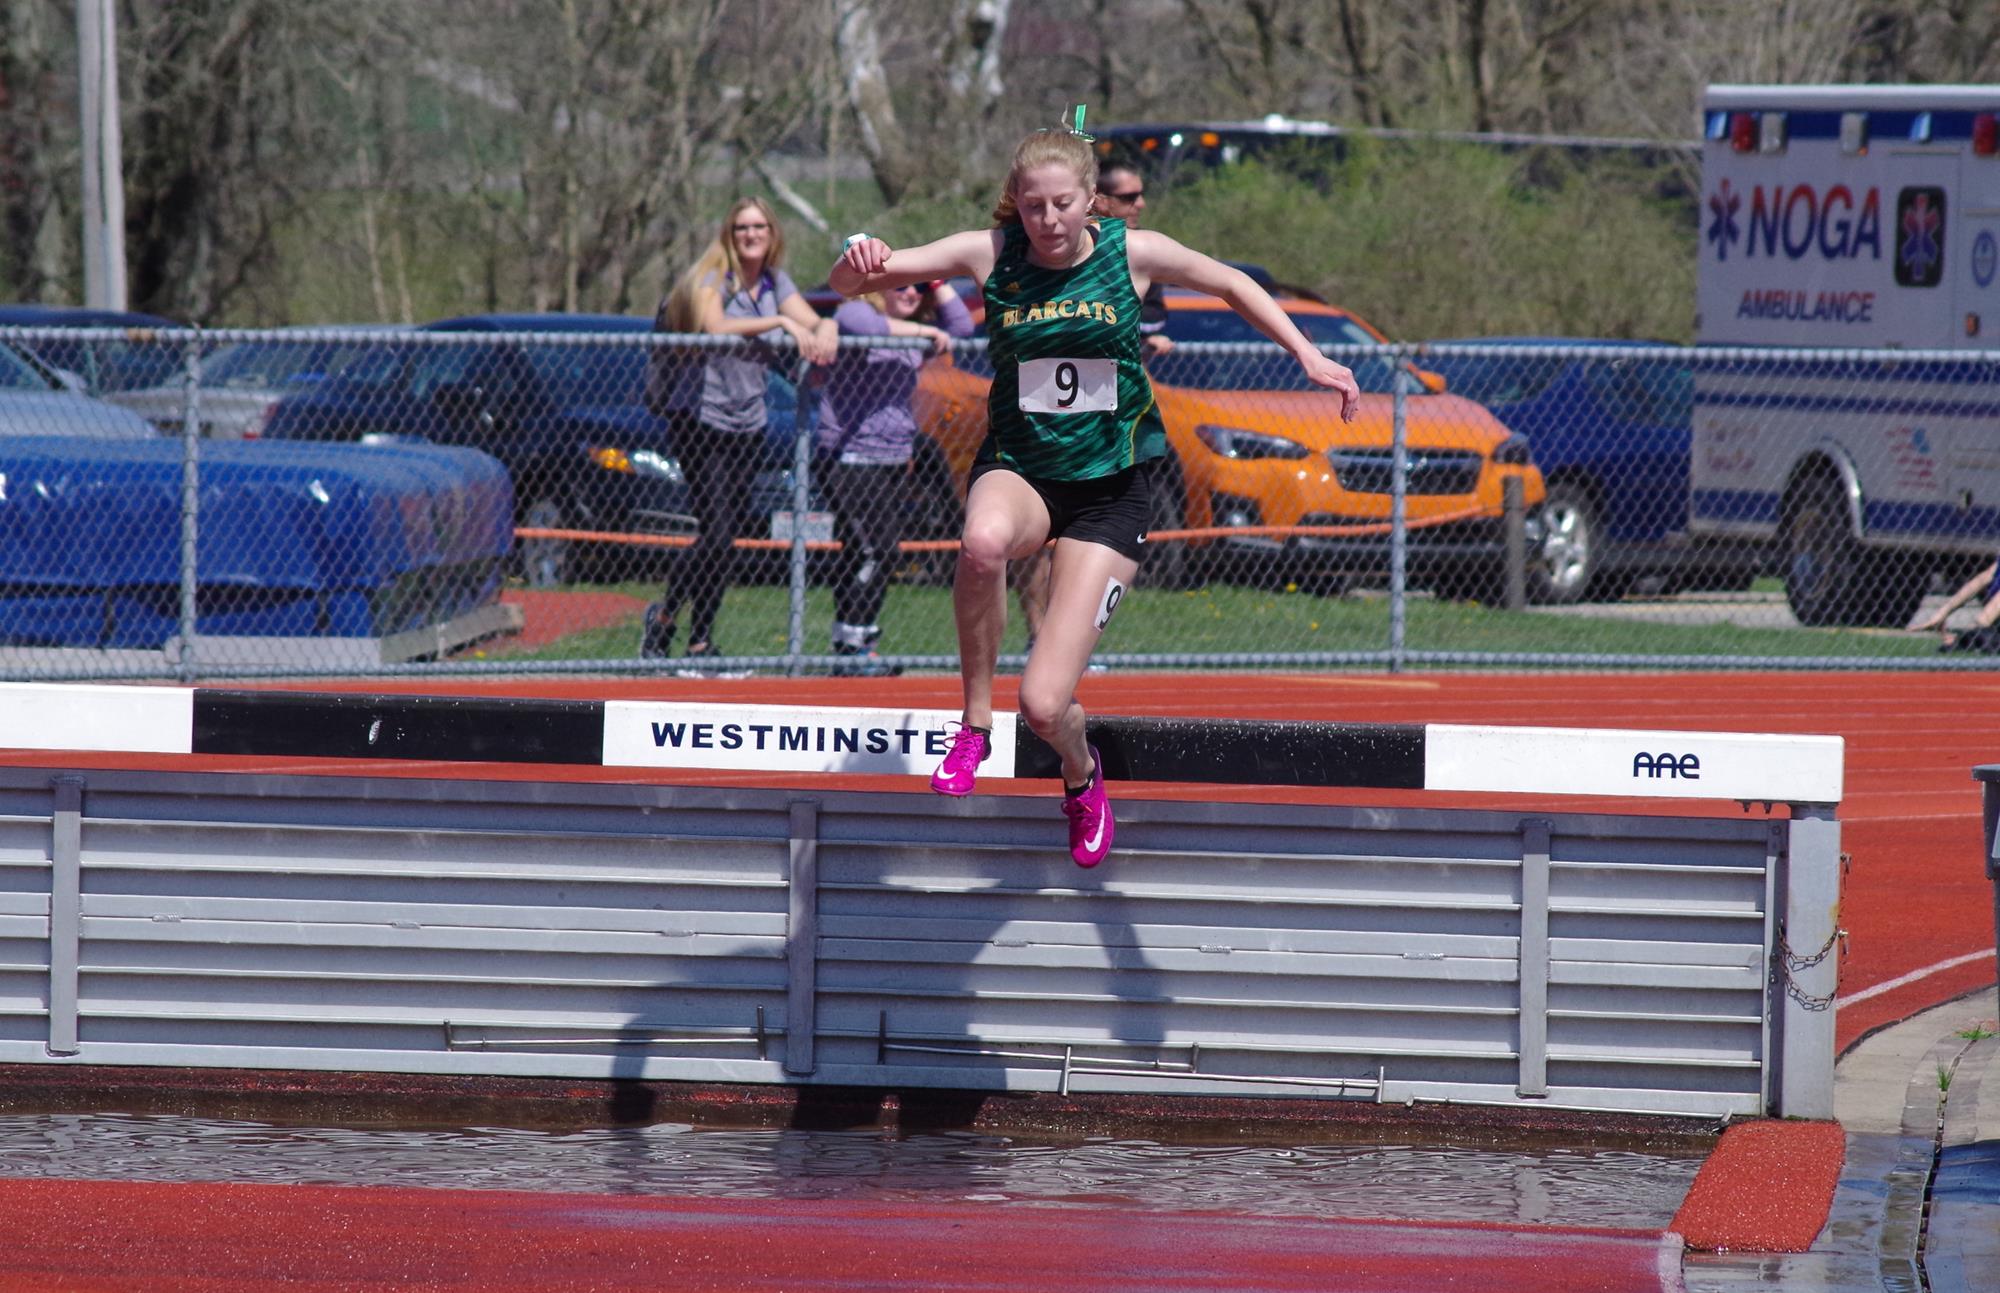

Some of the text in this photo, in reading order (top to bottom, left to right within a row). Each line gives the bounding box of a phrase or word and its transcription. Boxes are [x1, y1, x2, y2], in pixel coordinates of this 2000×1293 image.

[1746, 184, 1881, 260] NOGA
[1736, 289, 1875, 323] AMBULANCE
[1054, 361, 1080, 407] 9
[651, 721, 948, 756] WESTMINSTE
